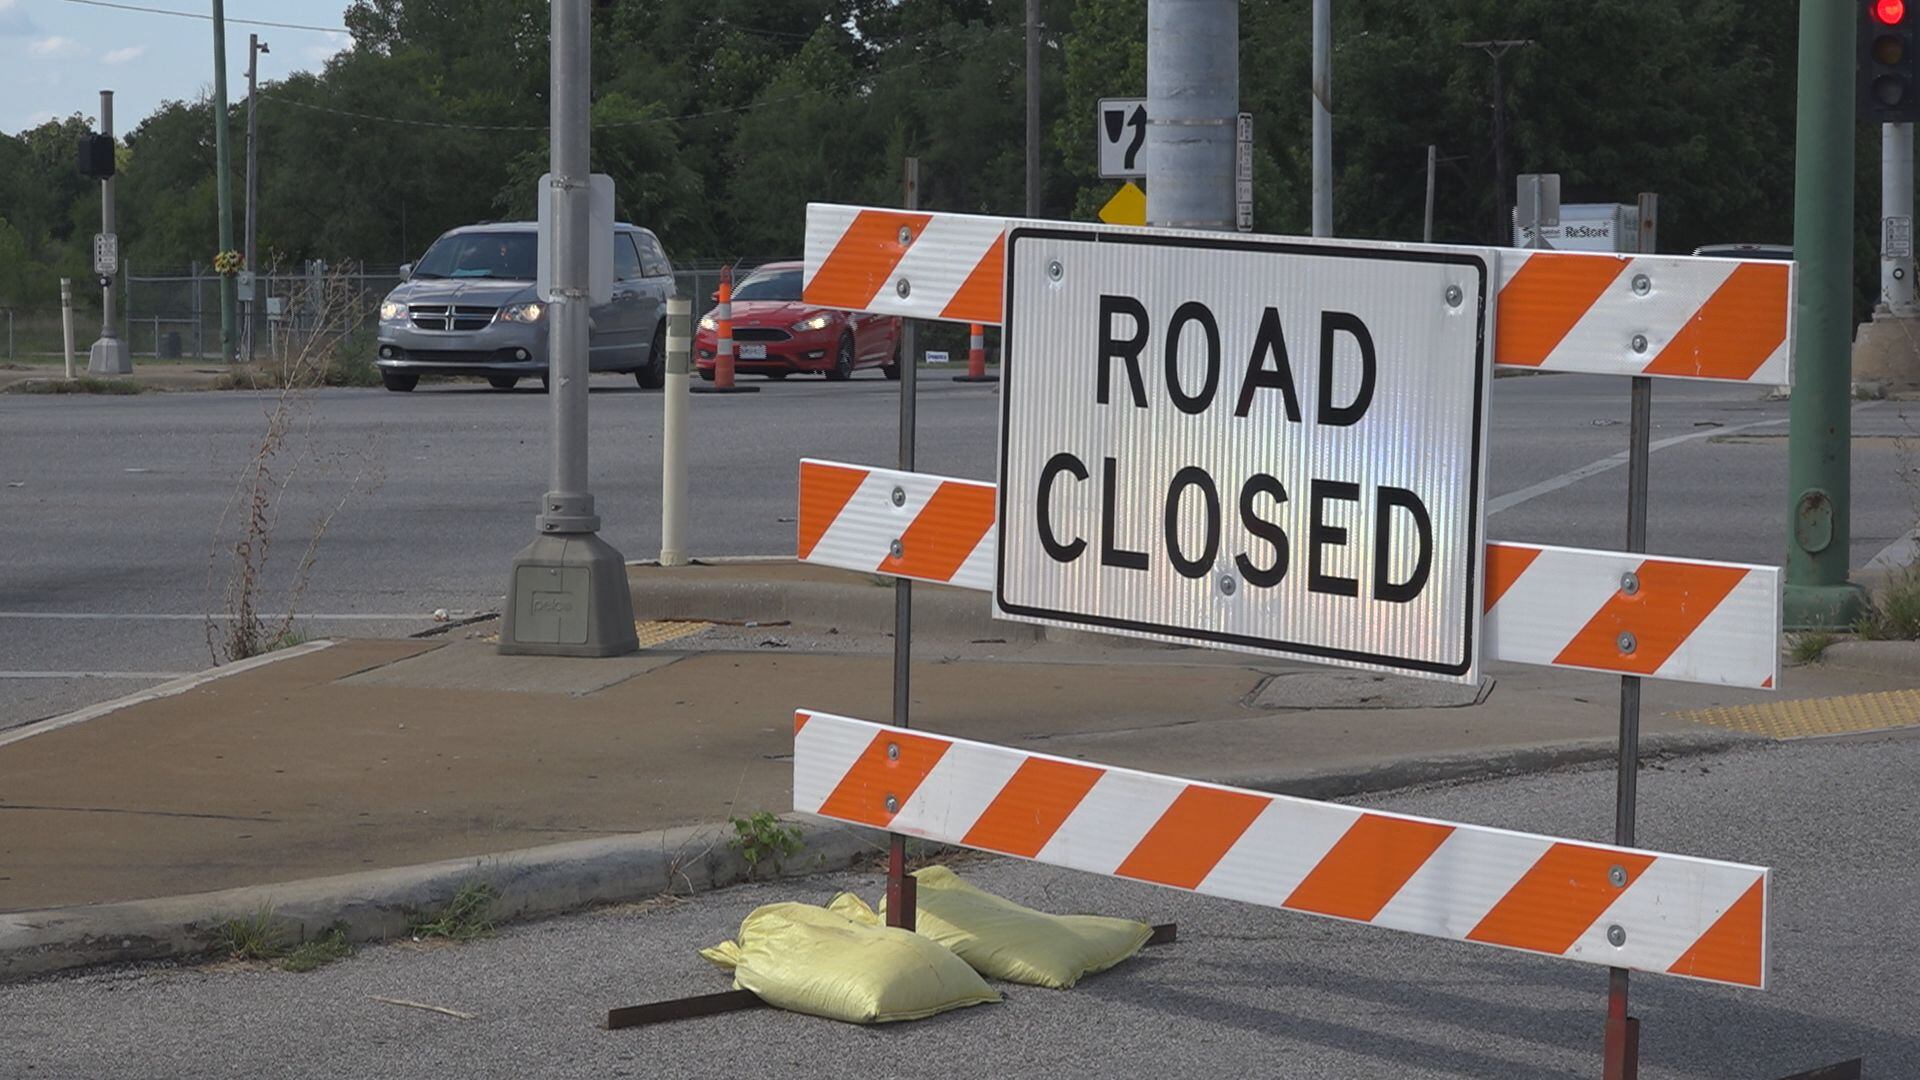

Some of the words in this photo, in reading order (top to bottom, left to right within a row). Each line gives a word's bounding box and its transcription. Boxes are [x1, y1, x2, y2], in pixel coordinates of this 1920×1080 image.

[1565, 226, 1609, 238] ReStore
[1097, 295, 1377, 427] ROAD
[1036, 453, 1433, 603] CLOSED
